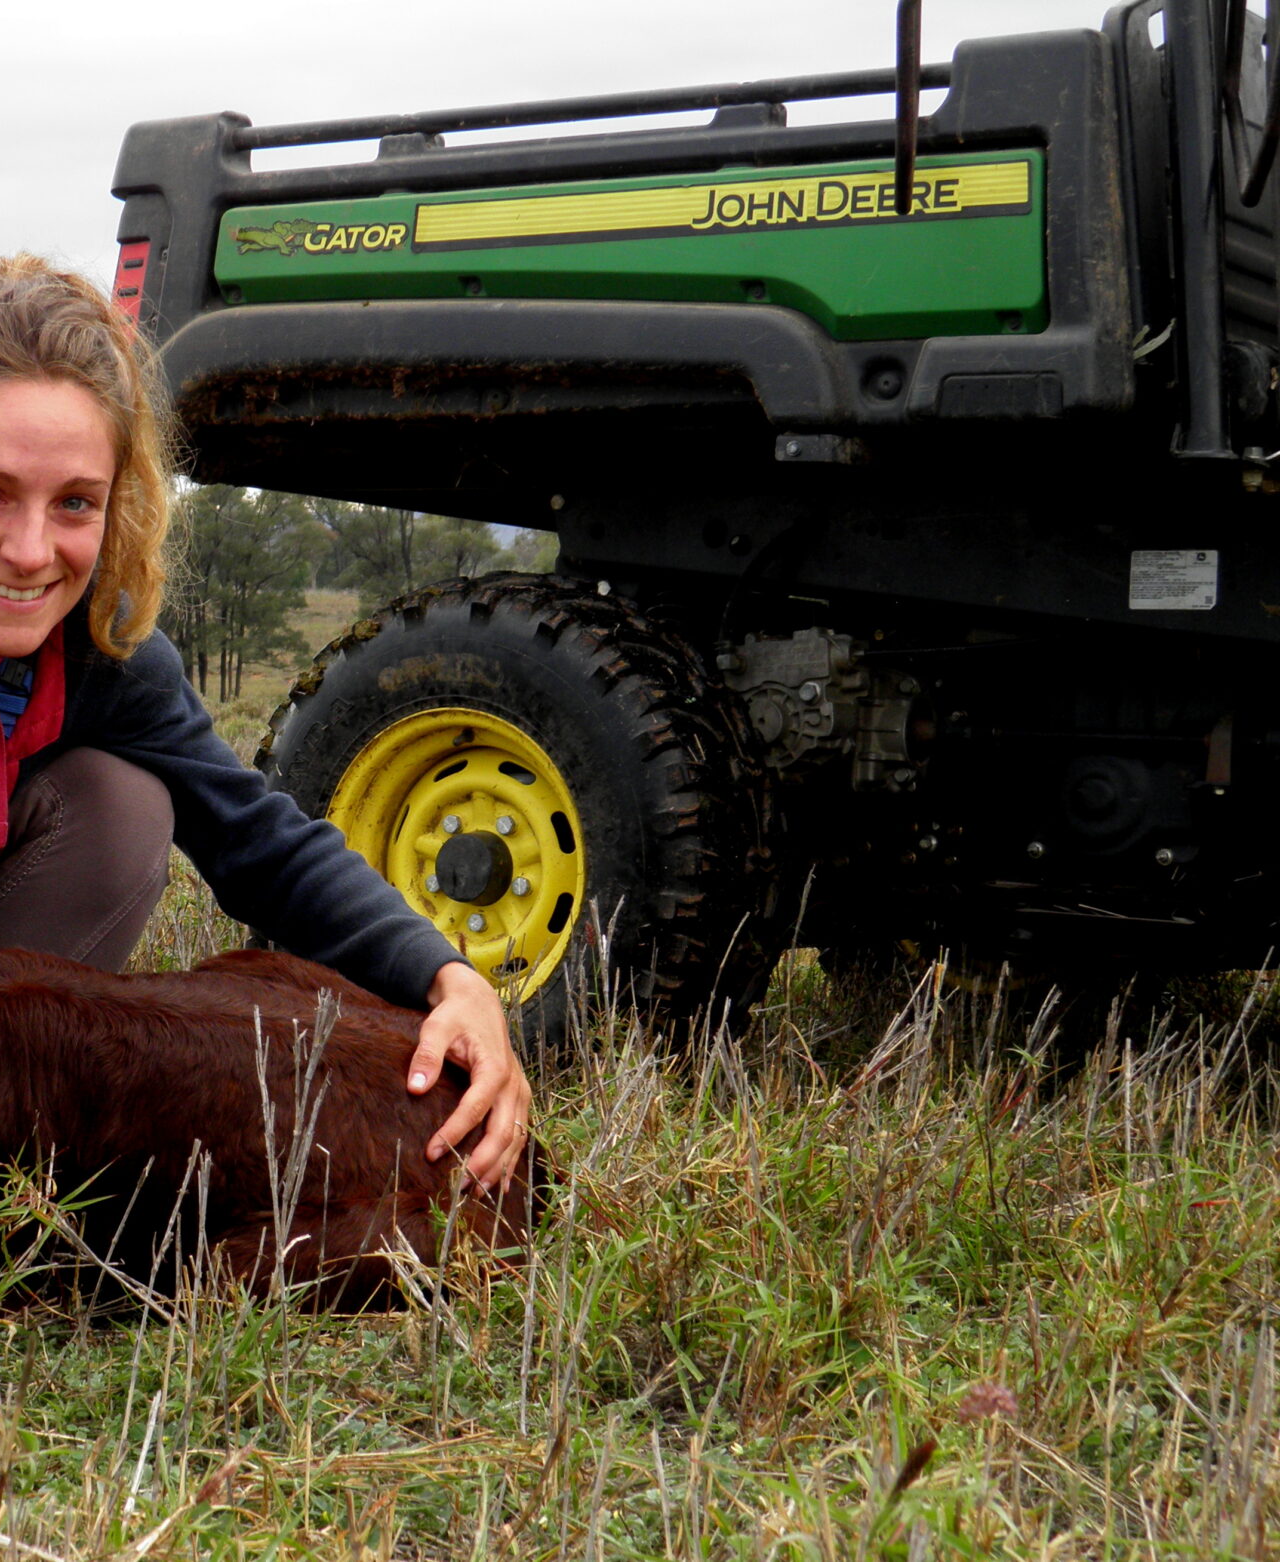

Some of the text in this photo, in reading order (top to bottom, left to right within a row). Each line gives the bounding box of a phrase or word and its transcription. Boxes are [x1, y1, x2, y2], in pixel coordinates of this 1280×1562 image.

[691, 179, 959, 226] JOHN DEERE
[303, 223, 408, 252] GATOR
